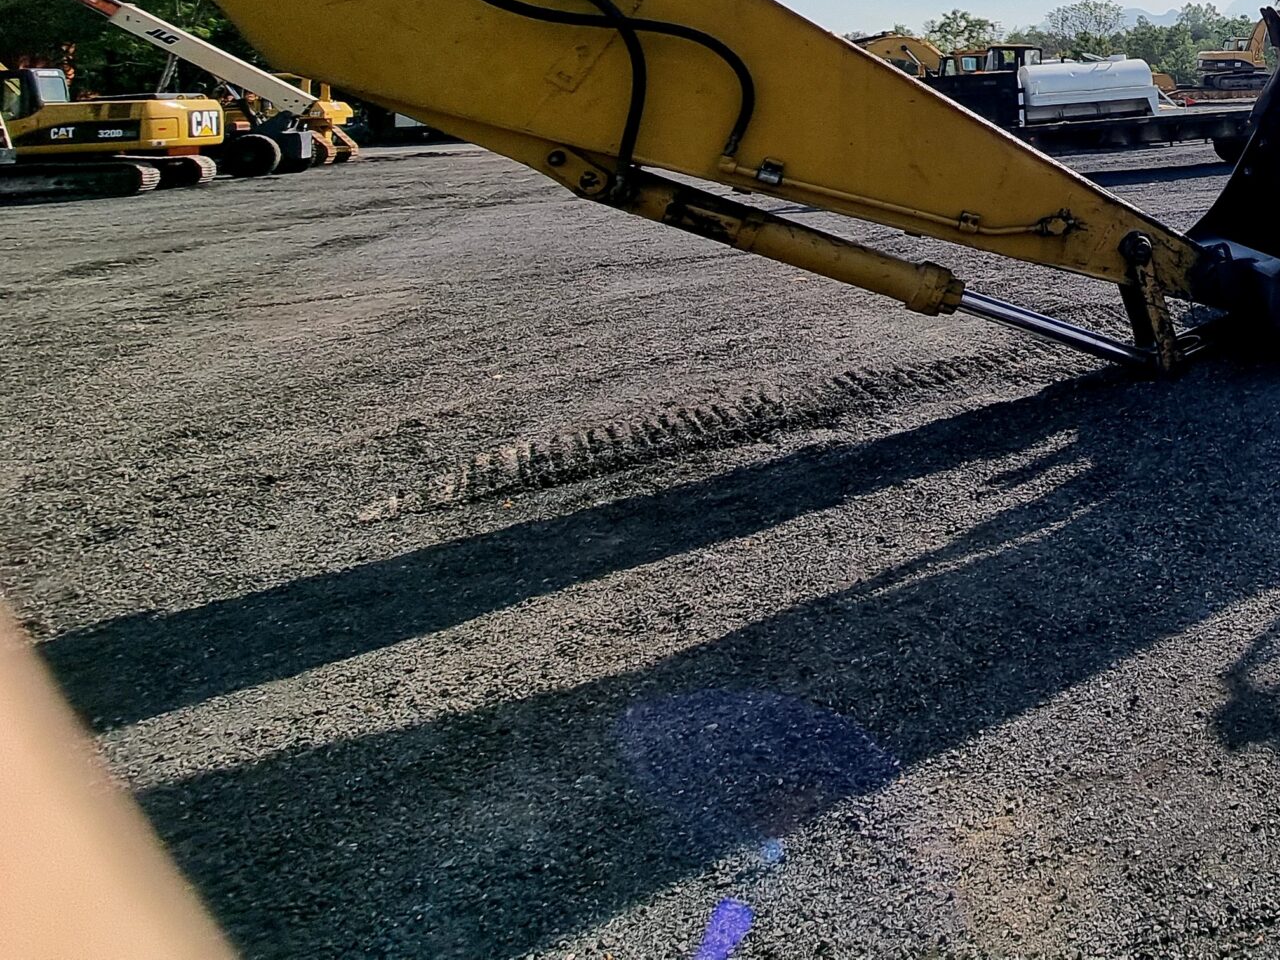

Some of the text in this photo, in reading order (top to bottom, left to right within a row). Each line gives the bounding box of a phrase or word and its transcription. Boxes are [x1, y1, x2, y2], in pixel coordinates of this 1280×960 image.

[144, 28, 181, 45] JLG
[191, 110, 218, 137] CAT
[50, 126, 75, 140] CAT
[97, 129, 123, 138] 320D
